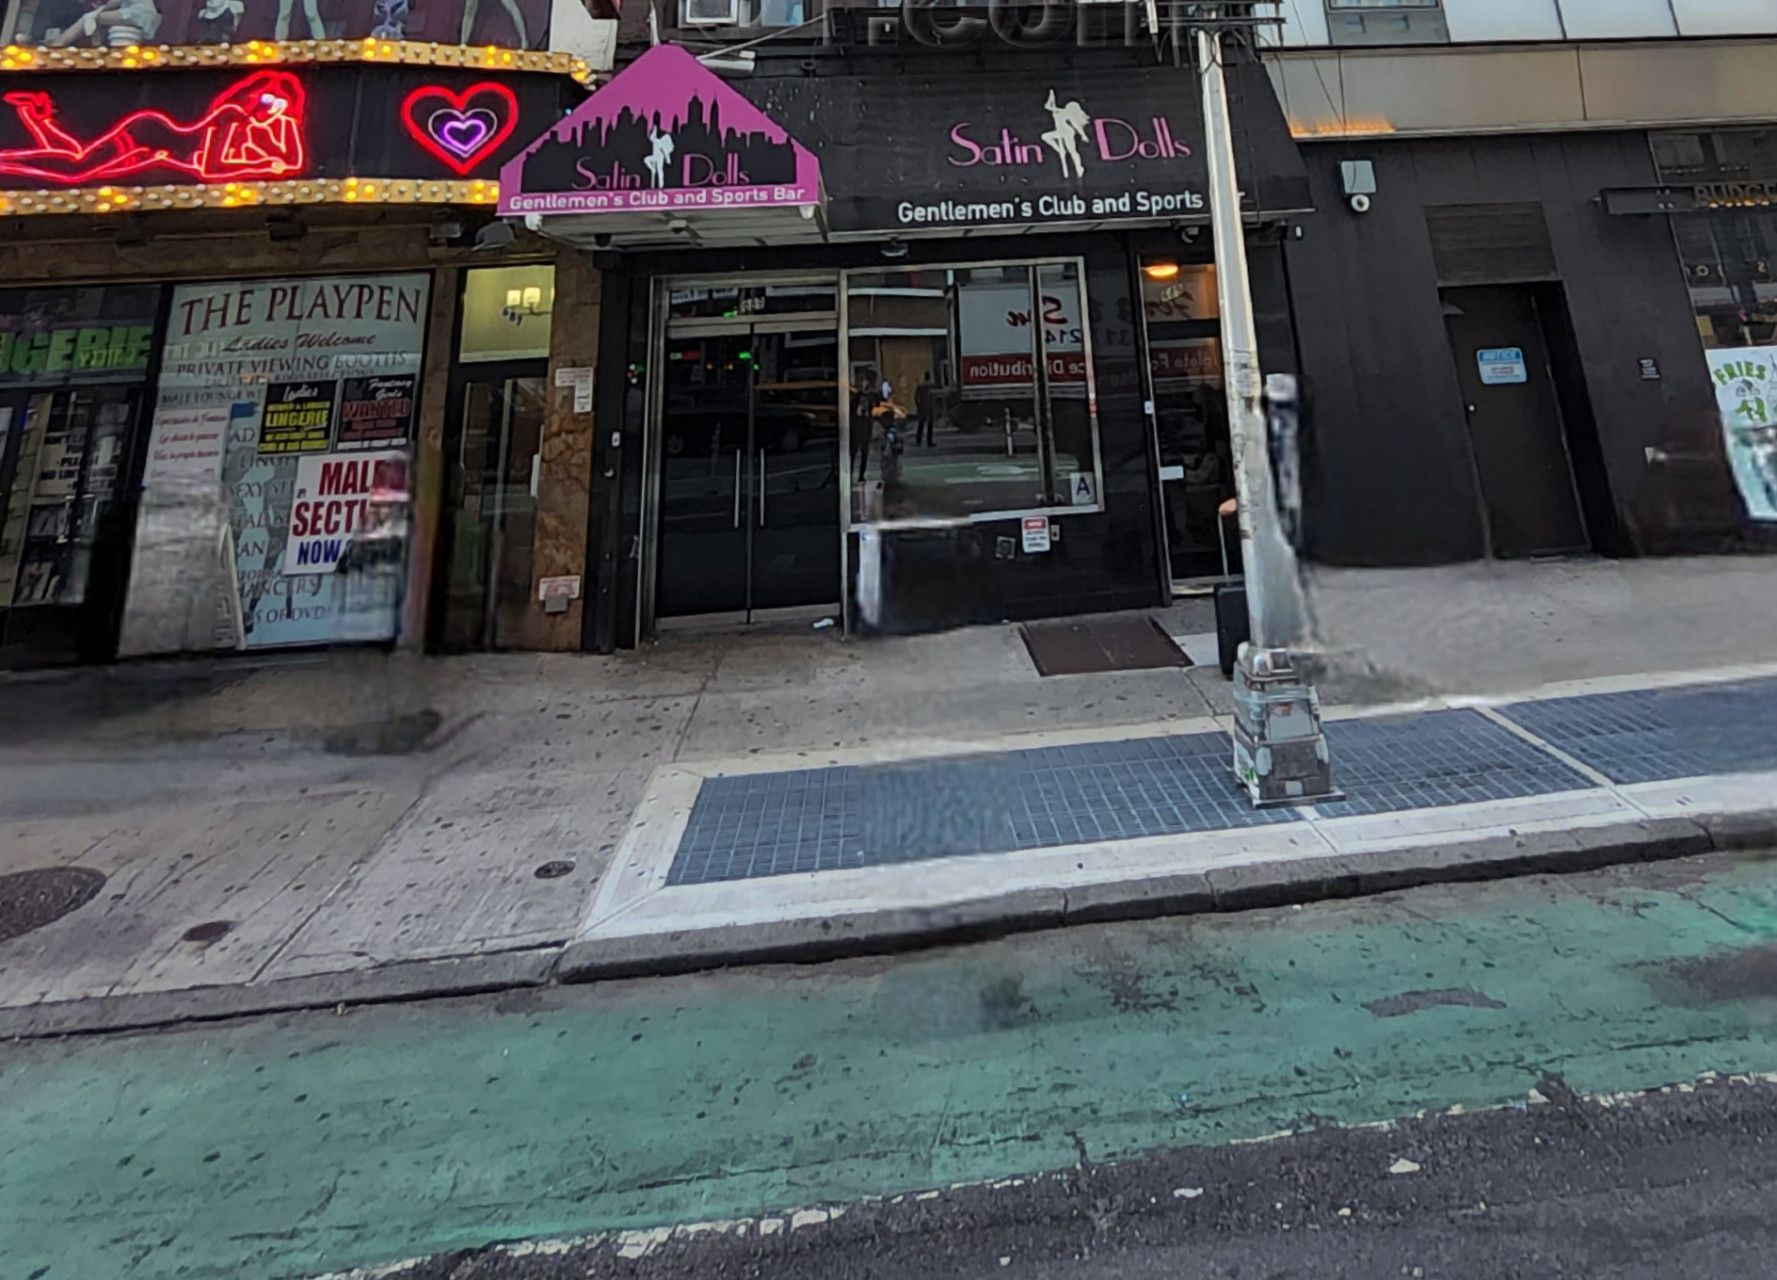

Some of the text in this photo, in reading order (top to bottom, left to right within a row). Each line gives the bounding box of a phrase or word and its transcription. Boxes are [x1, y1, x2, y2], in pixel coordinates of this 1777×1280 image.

[947, 118, 1192, 166] Satin Dolls
[572, 154, 750, 190] Satin Dolls
[510, 187, 806, 211] Gentlemen's Club and Sports Bar
[898, 190, 1203, 223] Gentlemen's Club and Sports
[180, 284, 421, 336] THE PLAYPEN
[222, 335, 288, 352] Ladies
[296, 332, 376, 348] Welcome
[177, 351, 406, 377] PRIVATE VIEWING BOOTHS
[265, 410, 329, 428] LINGERIE
[1076, 475, 1090, 495] A
[293, 500, 366, 536] SECTI
[297, 540, 341, 565] NOW
